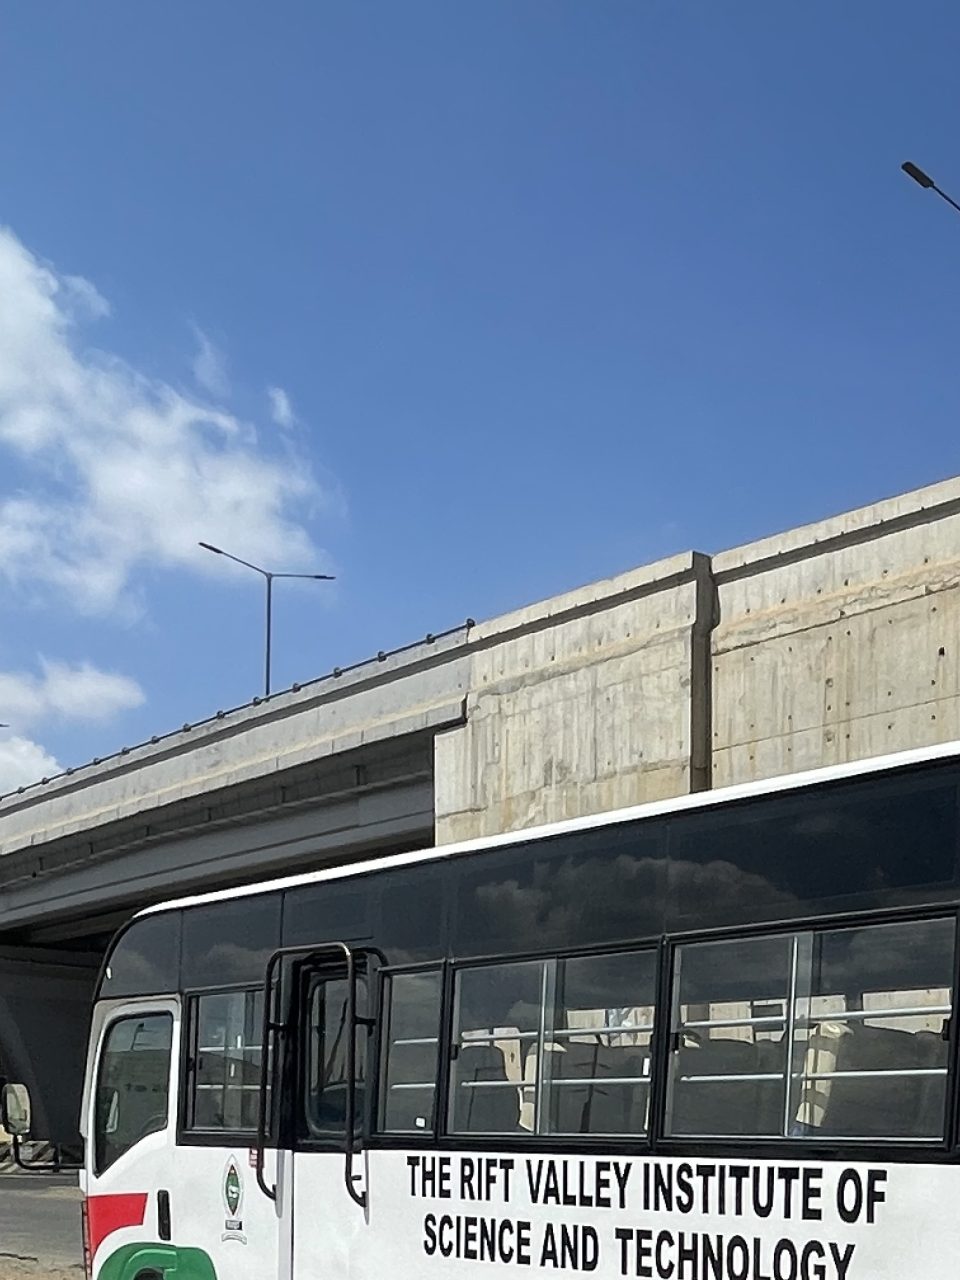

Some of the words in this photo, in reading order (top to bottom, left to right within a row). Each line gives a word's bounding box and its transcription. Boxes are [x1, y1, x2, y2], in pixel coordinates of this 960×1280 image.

[407, 1156, 450, 1199] THE
[460, 1157, 514, 1201] RIFT
[526, 1159, 632, 1209] VALLEY
[643, 1163, 823, 1221] INSTITUTE
[836, 1168, 888, 1224] OF
[423, 1213, 531, 1265] SCIENCE
[540, 1223, 599, 1272] AND
